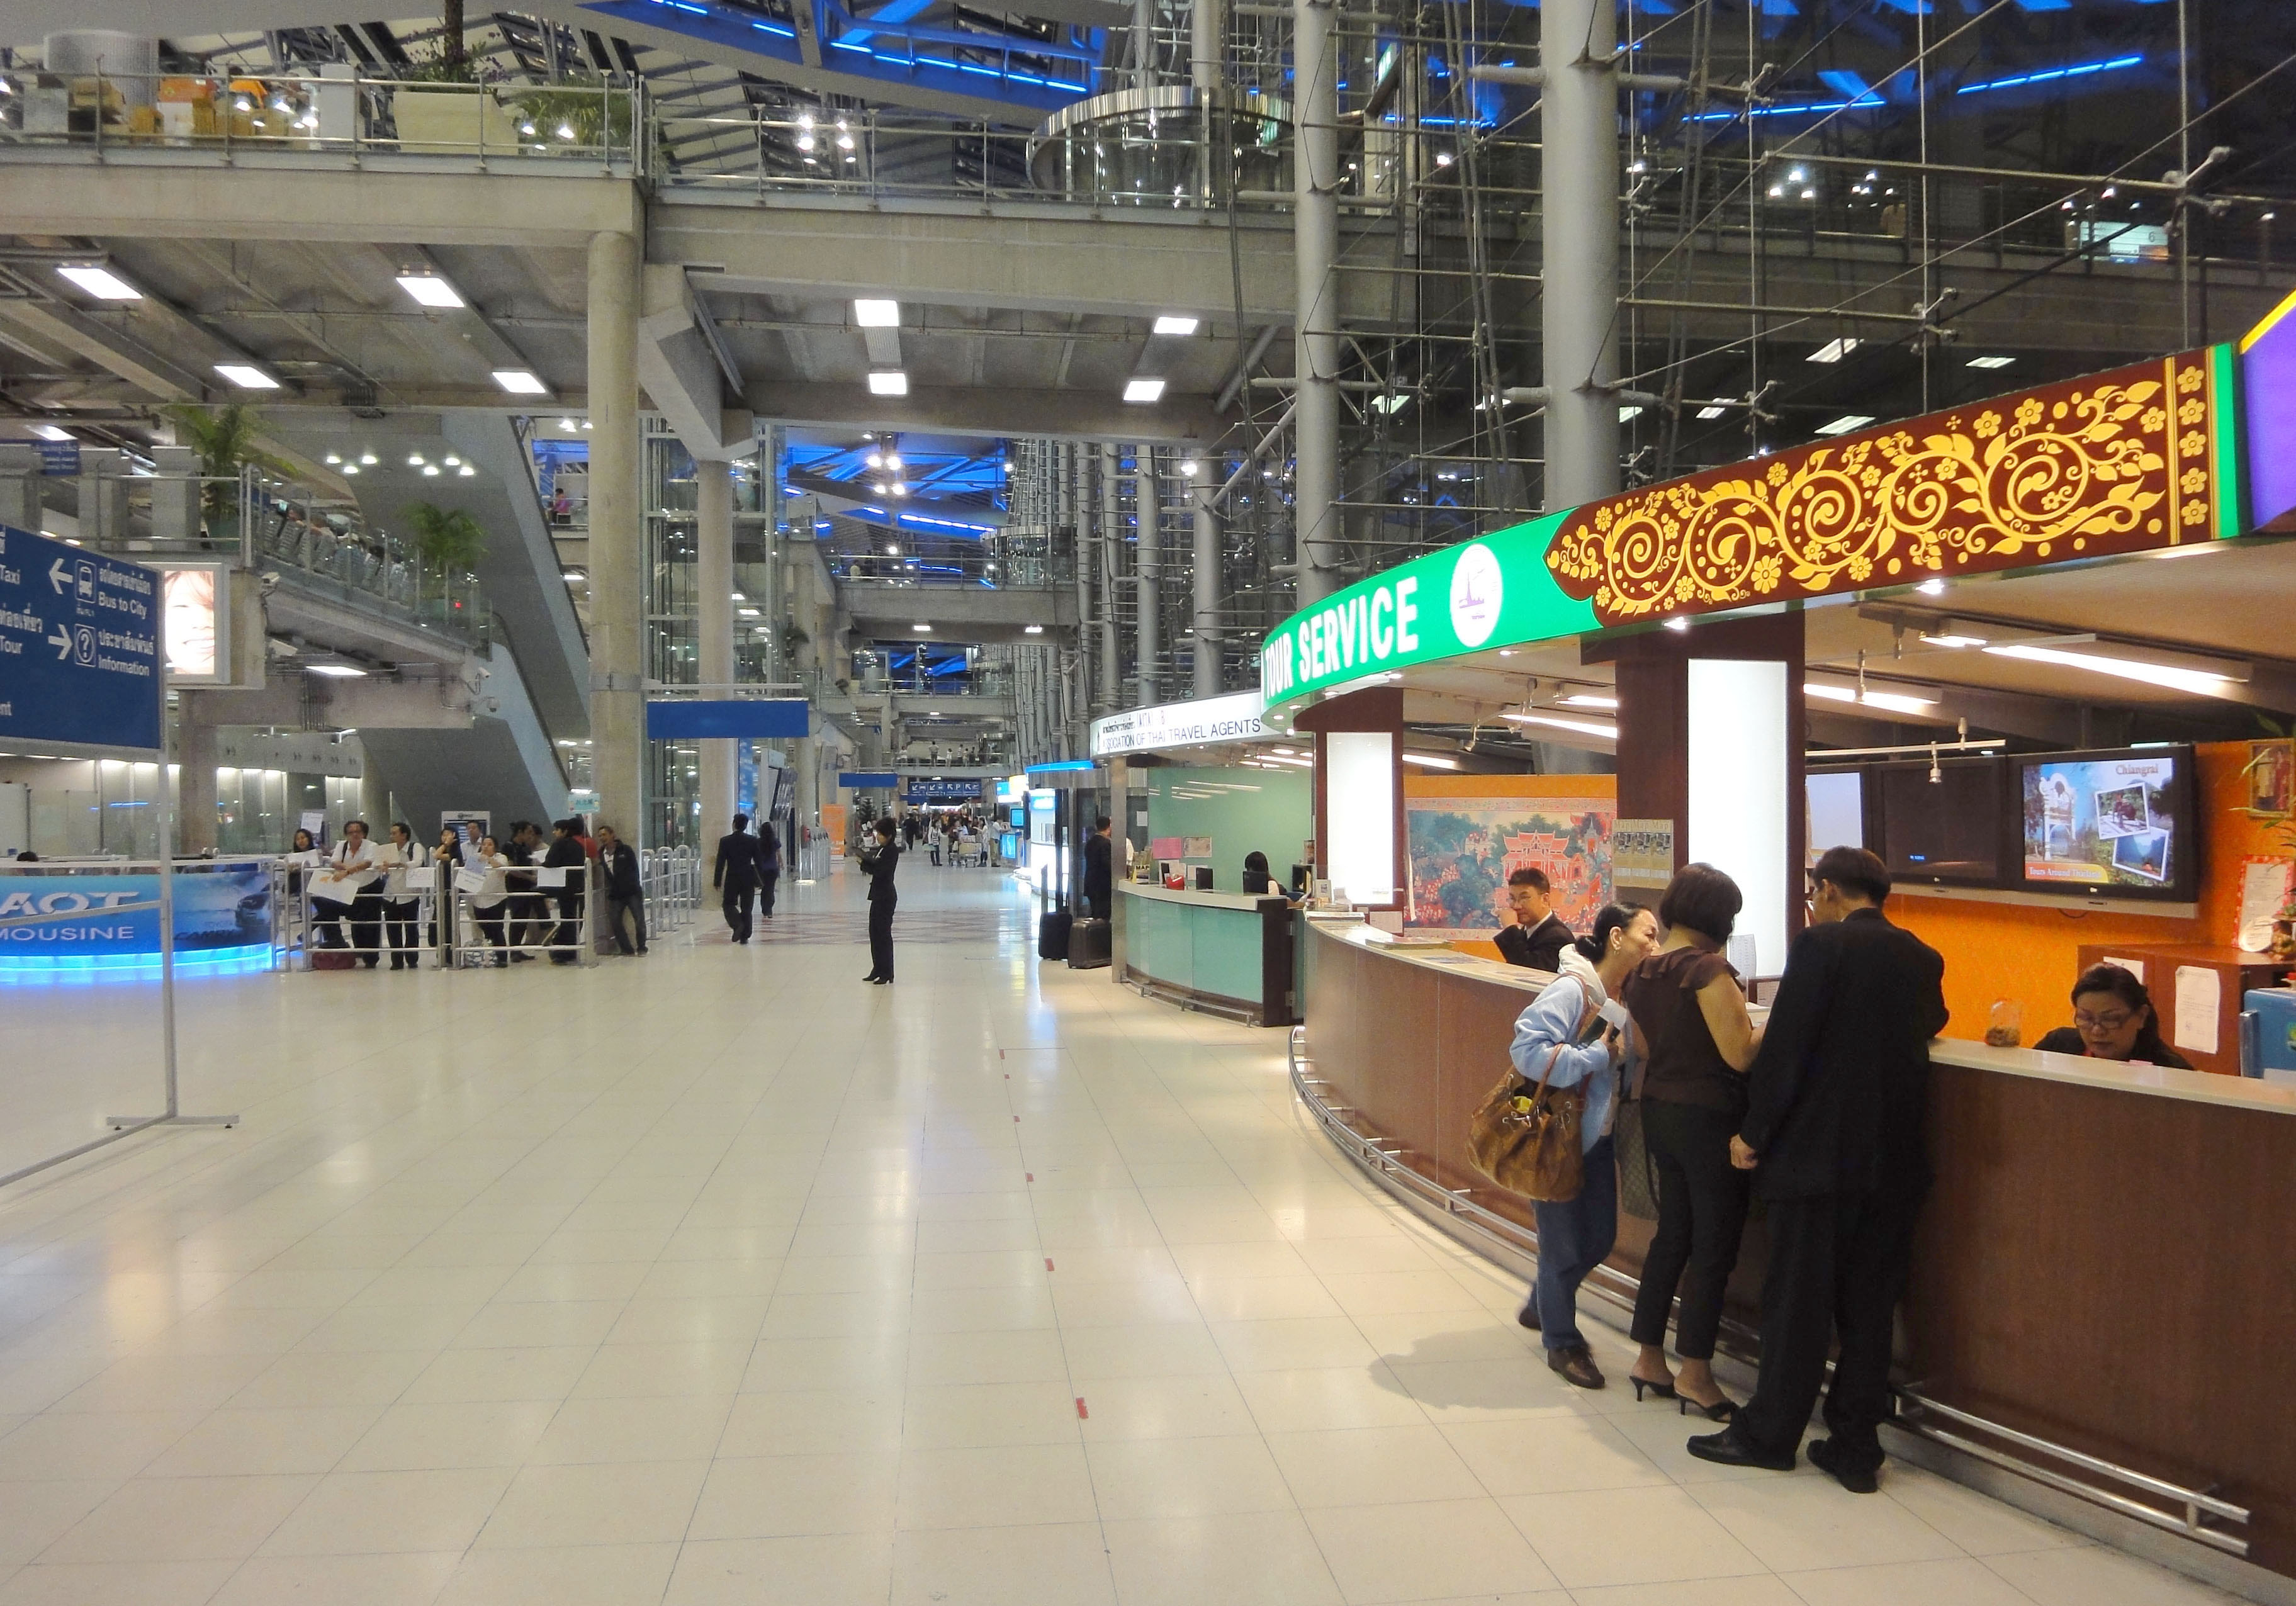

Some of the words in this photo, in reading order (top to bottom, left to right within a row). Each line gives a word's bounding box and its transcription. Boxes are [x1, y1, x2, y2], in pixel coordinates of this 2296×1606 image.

[0, 564, 21, 585] Taxi
[98, 590, 116, 609] Bus
[118, 597, 128, 612] to
[130, 598, 147, 620] City
[0, 634, 23, 654] Tour
[1265, 632, 1293, 700] TOUR
[1299, 576, 1419, 683] SERVICE
[98, 654, 150, 677] Information
[1135, 733, 1145, 746] OF
[1148, 731, 1166, 746] THAI
[1169, 725, 1207, 743] TRAVEL
[1210, 717, 1261, 738] AGENTS
[2115, 763, 2159, 778] Chiangrai
[2029, 867, 2046, 875] Tours
[2047, 868, 2070, 877] Around
[0, 891, 140, 915] AOT
